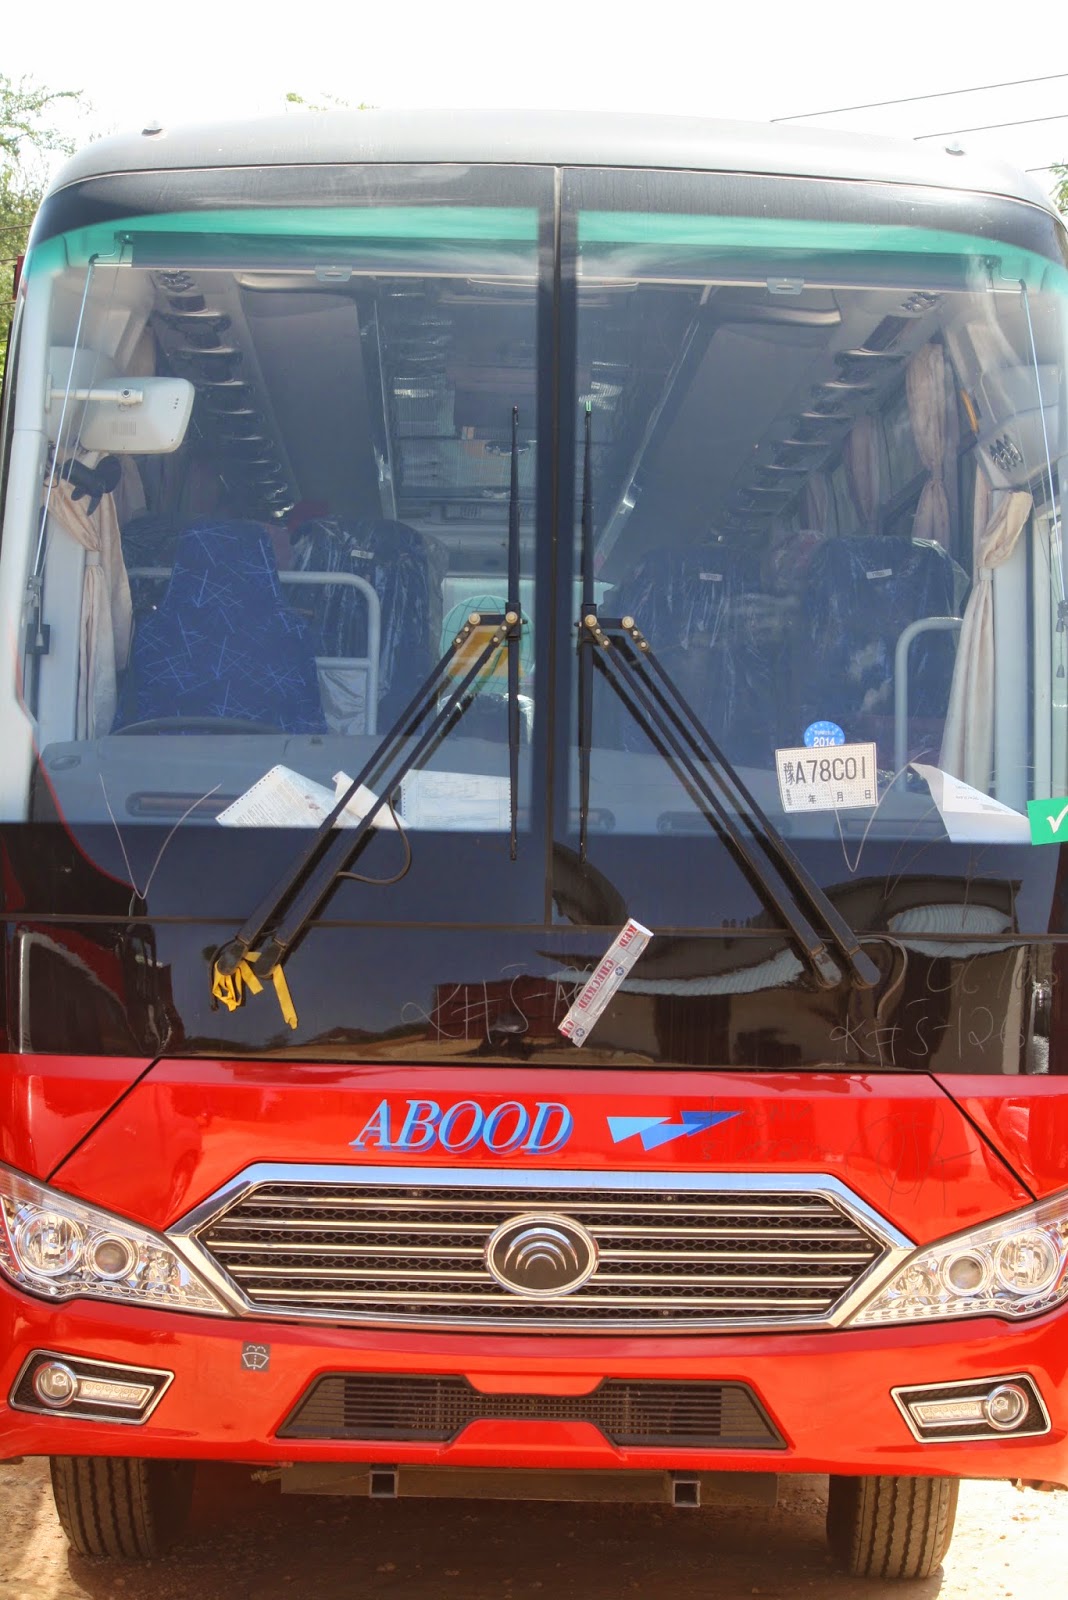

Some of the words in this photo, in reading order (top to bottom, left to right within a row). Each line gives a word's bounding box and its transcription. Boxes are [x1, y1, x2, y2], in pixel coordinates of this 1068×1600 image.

[813, 736, 836, 748] 2014
[577, 959, 614, 1009] CHECKED
[348, 1099, 573, 1155] ABOOD
